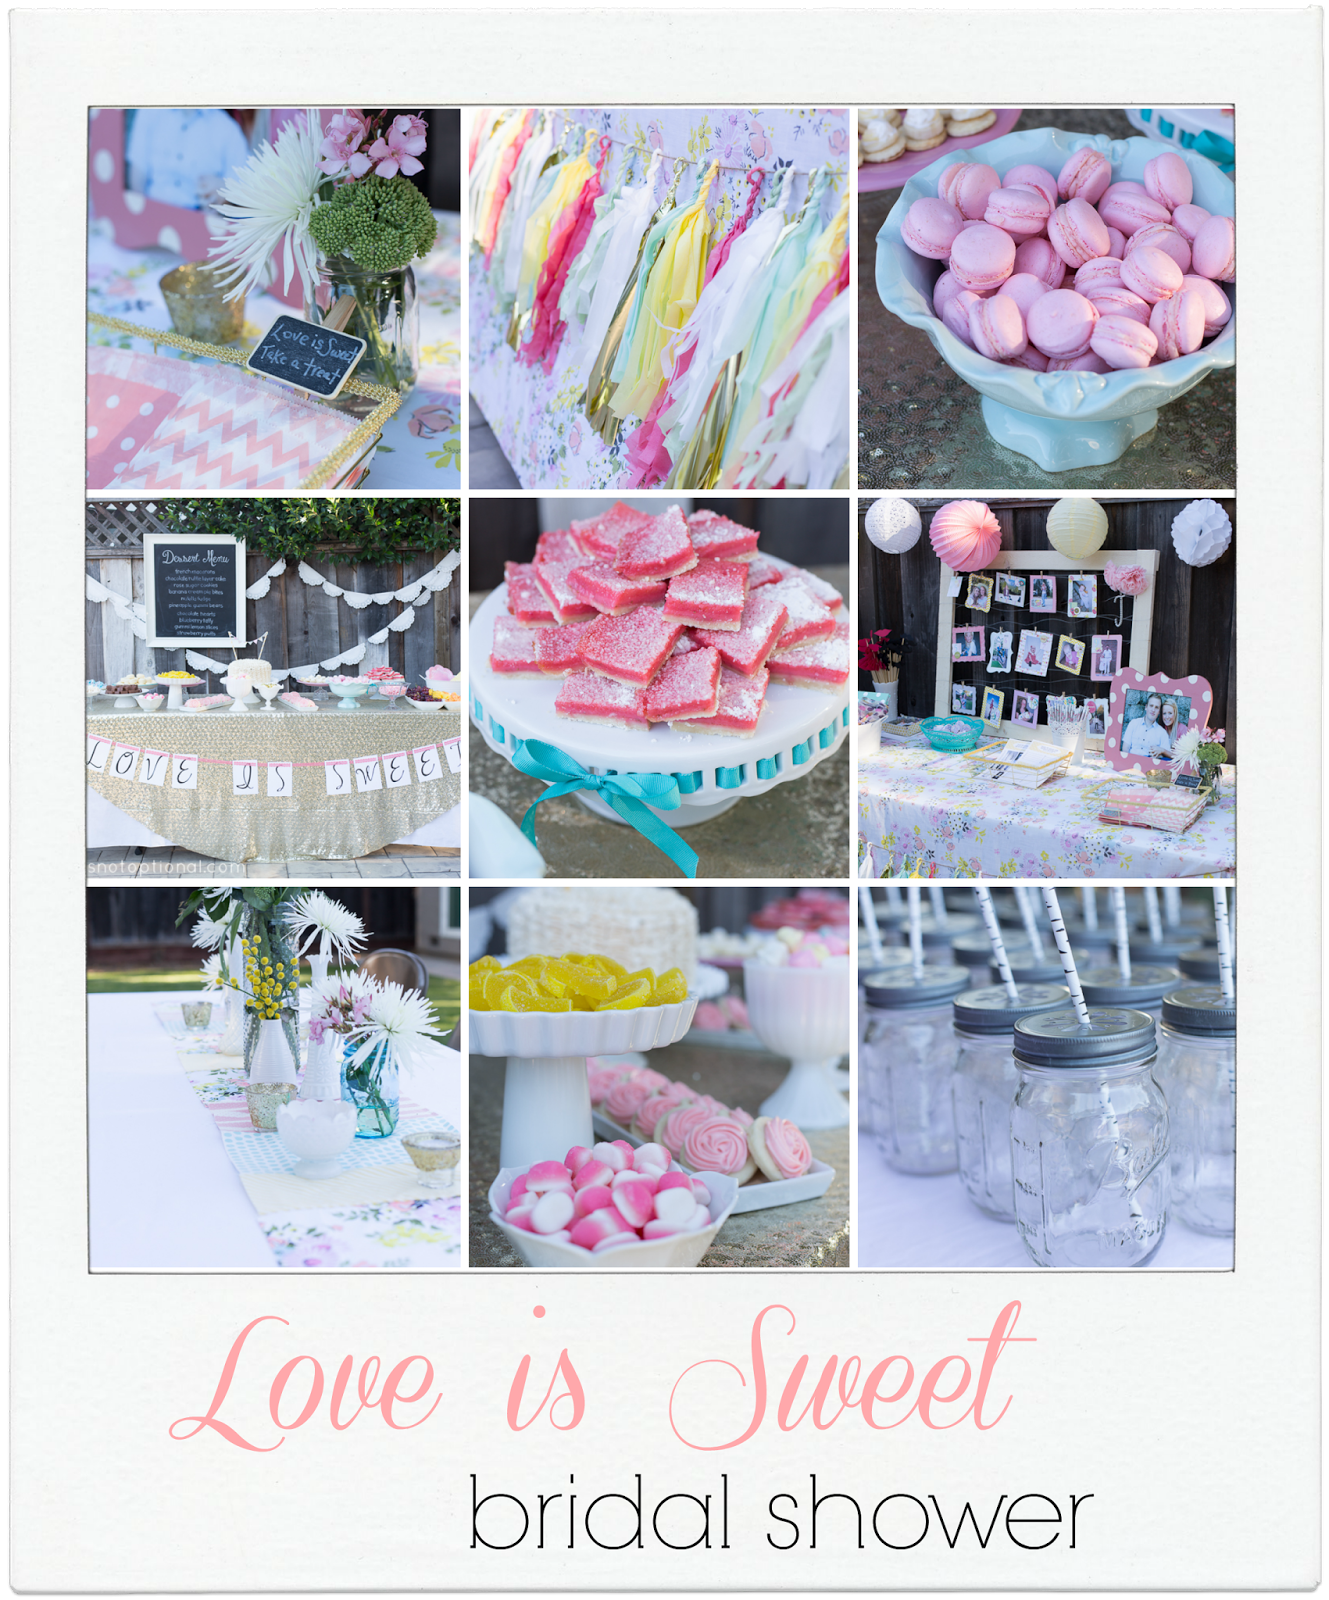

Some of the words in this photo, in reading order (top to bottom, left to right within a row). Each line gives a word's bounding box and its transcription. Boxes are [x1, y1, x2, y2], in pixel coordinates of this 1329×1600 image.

[271, 323, 309, 346] Love
[311, 334, 324, 350] is
[317, 337, 358, 364] Sweet
[261, 345, 287, 364] Take
[291, 359, 300, 370] a
[303, 358, 341, 385] treat
[162, 549, 200, 565] Dessert
[202, 549, 229, 567] Menu
[86, 740, 193, 784] LOVE
[236, 763, 285, 792] IS
